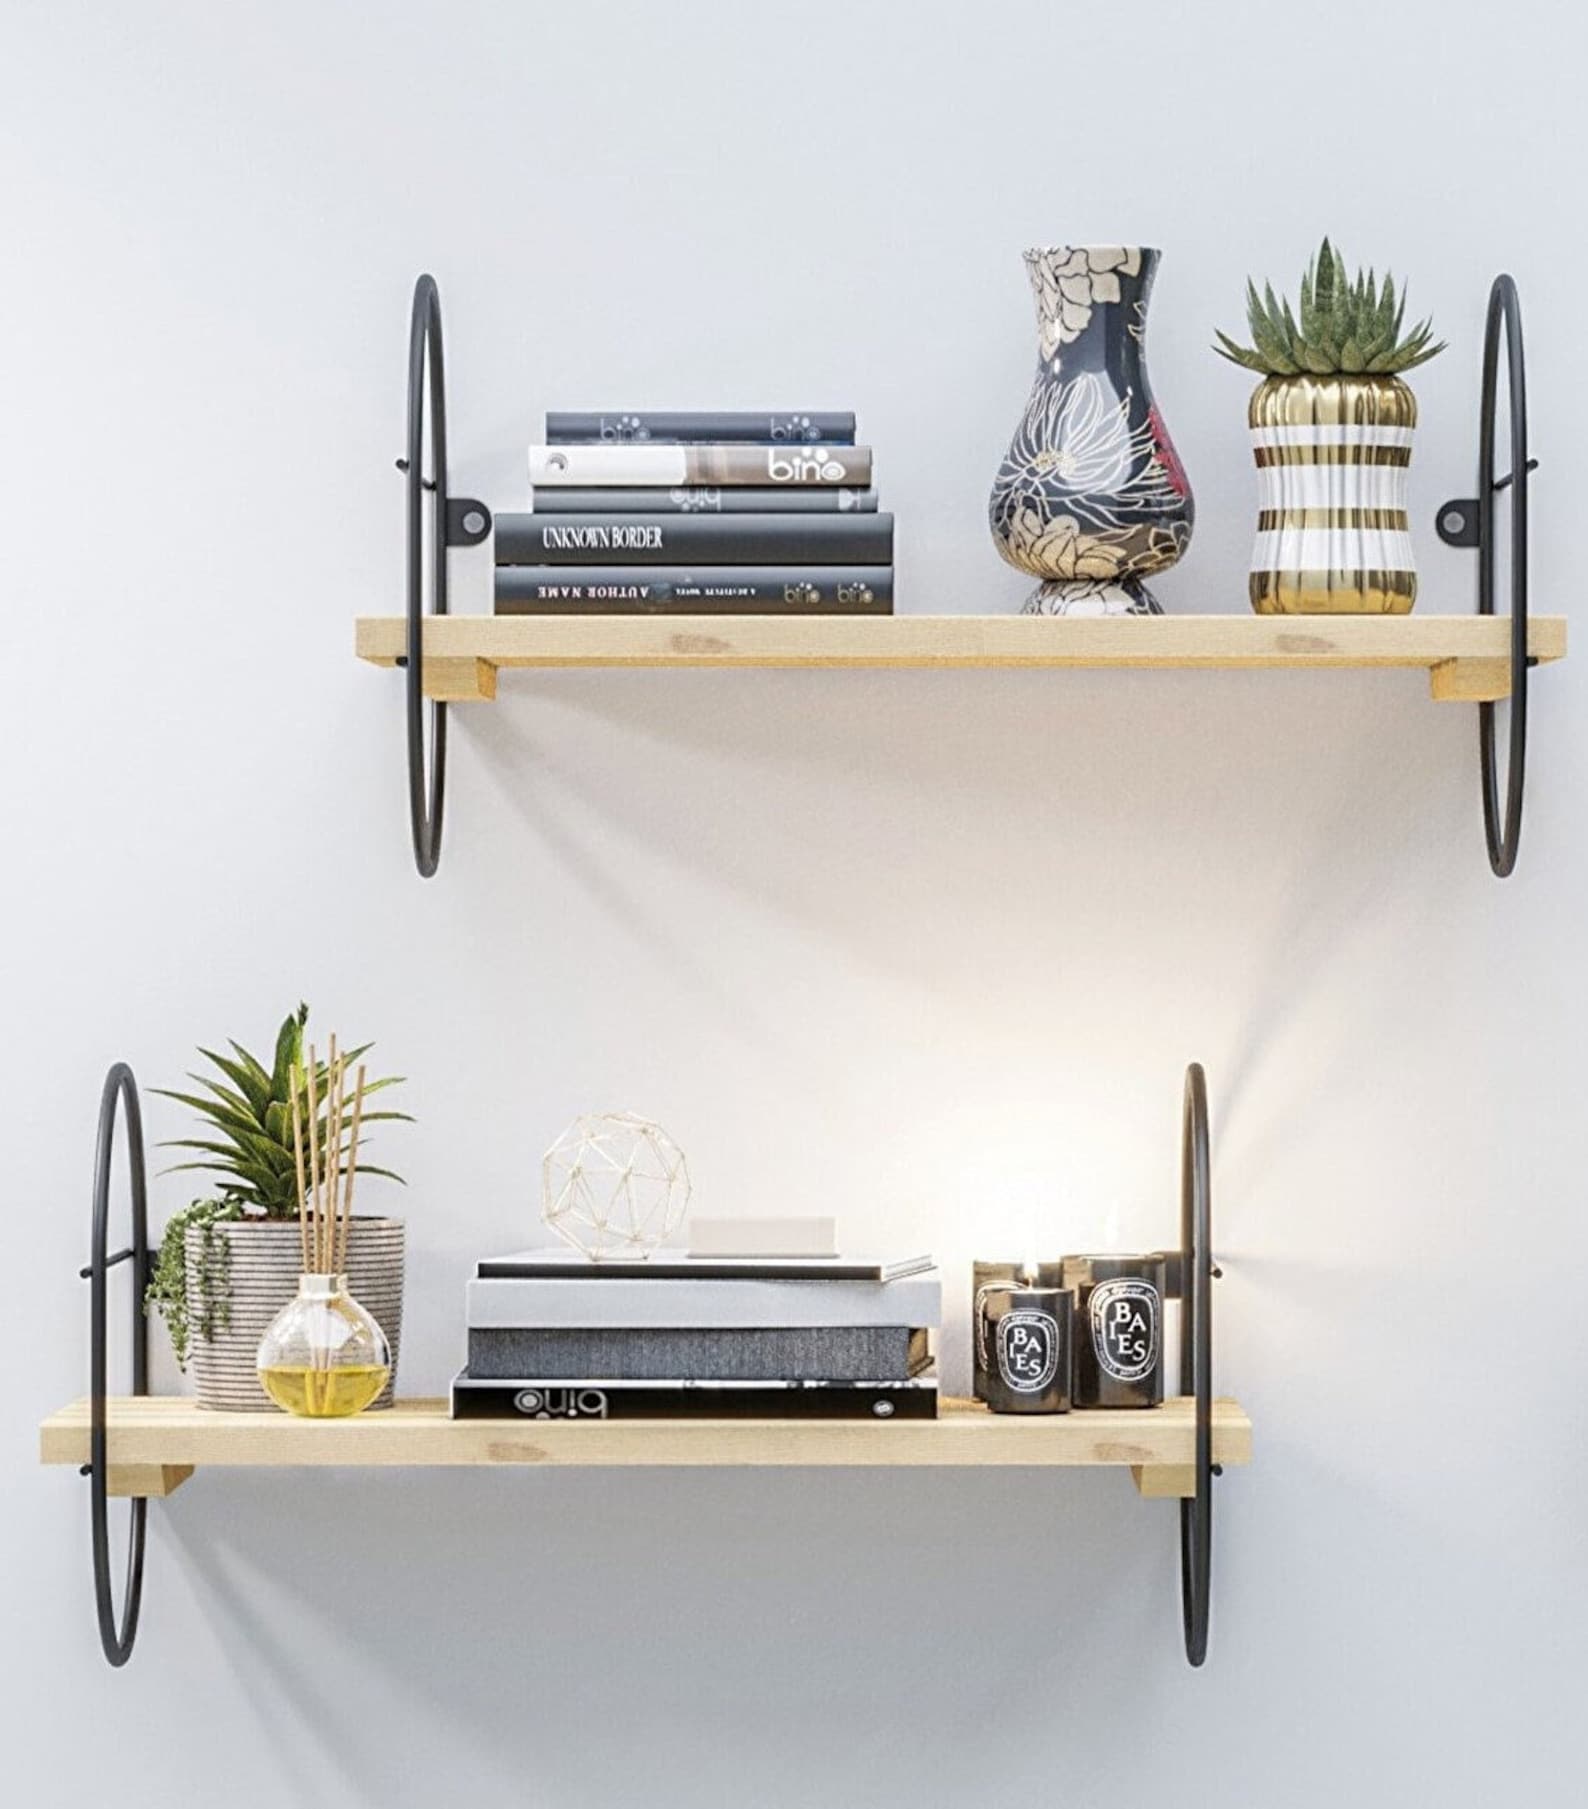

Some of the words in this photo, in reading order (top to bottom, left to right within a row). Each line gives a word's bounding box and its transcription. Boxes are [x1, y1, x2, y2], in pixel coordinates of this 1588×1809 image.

[600, 416, 649, 441] bino
[767, 446, 846, 482] bino
[543, 526, 610, 549] UNKNOWN
[612, 526, 662, 549] BORDER
[537, 585, 582, 599] NAME
[587, 585, 649, 599] AUTHOR
[513, 1389, 608, 1420] bino
